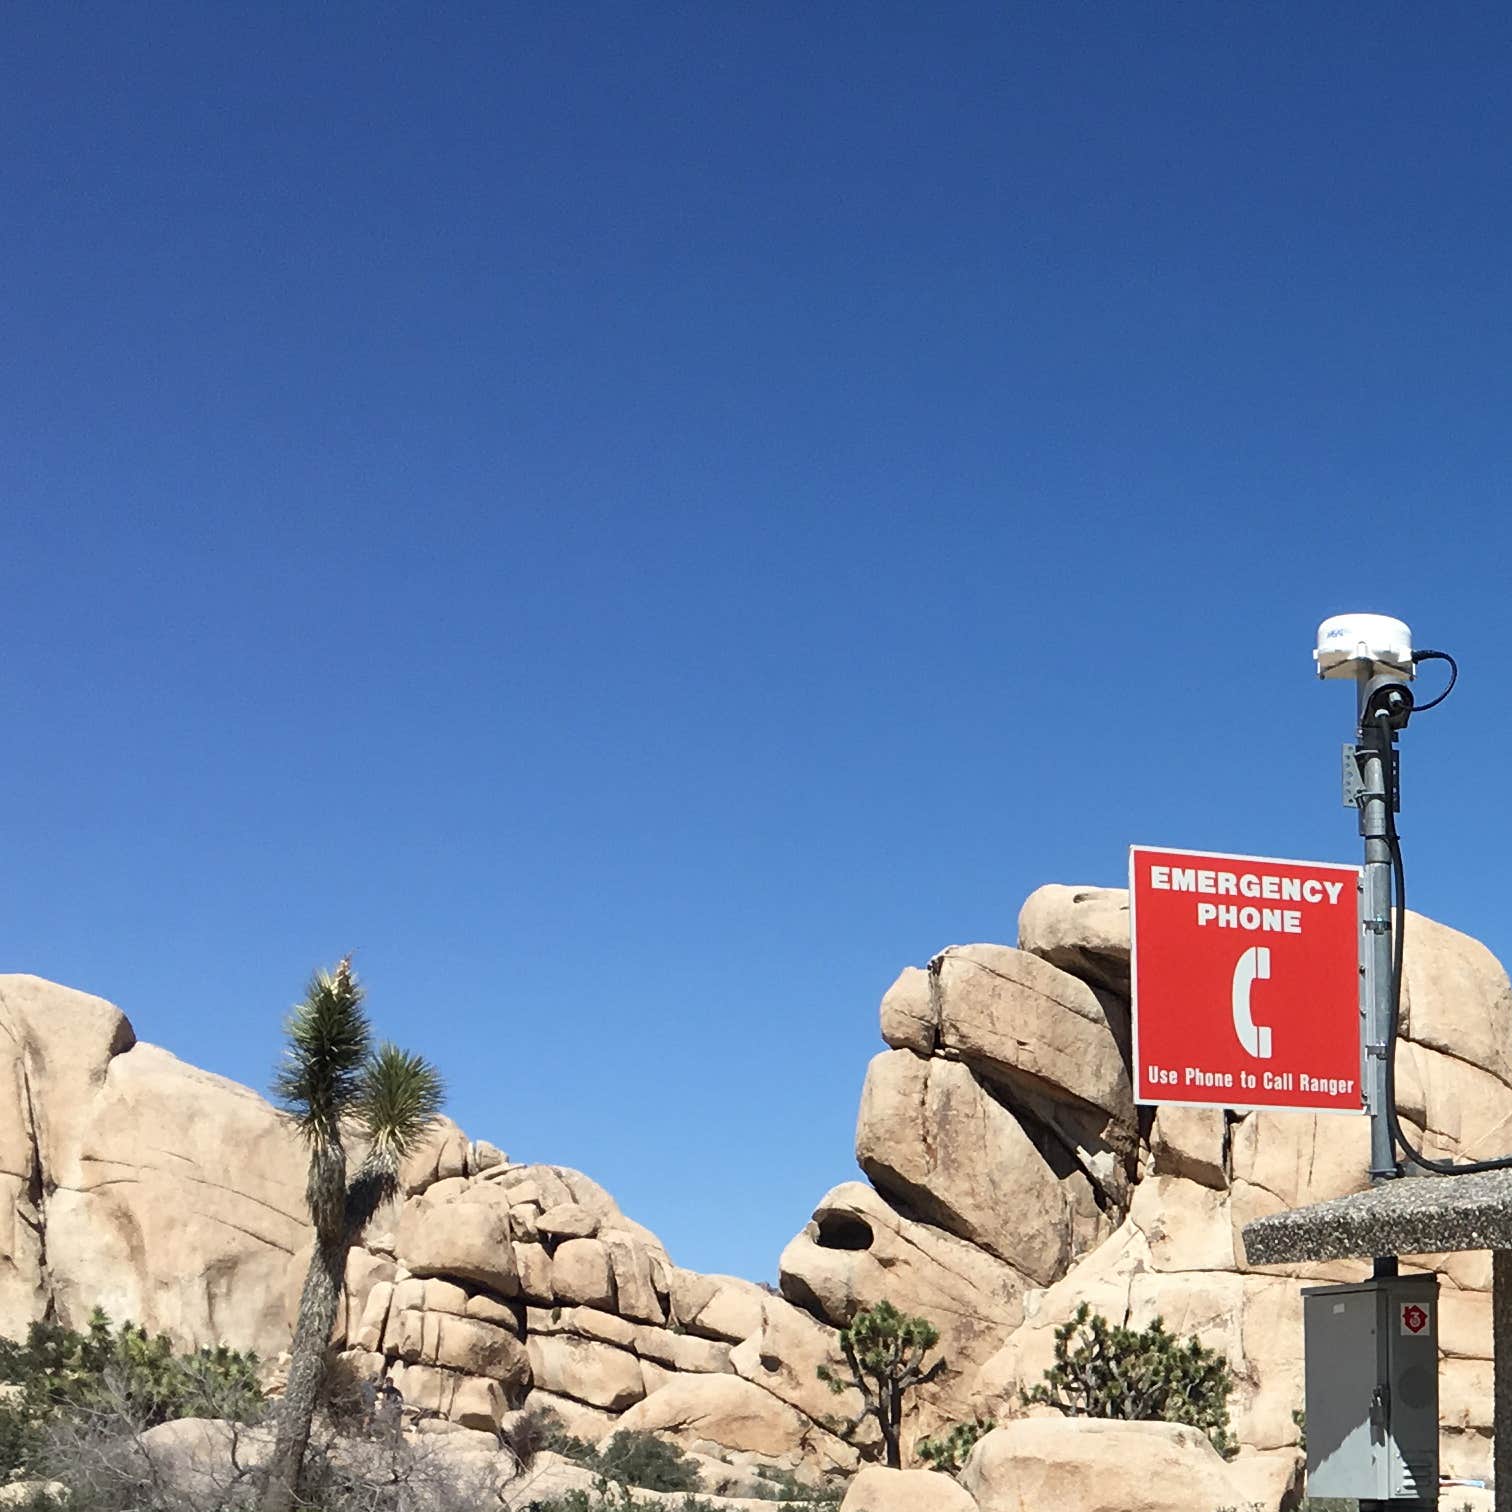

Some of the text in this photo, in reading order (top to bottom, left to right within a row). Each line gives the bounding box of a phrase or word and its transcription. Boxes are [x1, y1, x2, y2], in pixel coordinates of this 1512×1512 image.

[1150, 865, 1344, 905] EMERGENCY
[1197, 902, 1302, 934] PHONE
[1148, 1065, 1354, 1096] Use Phone to Call Ranger
